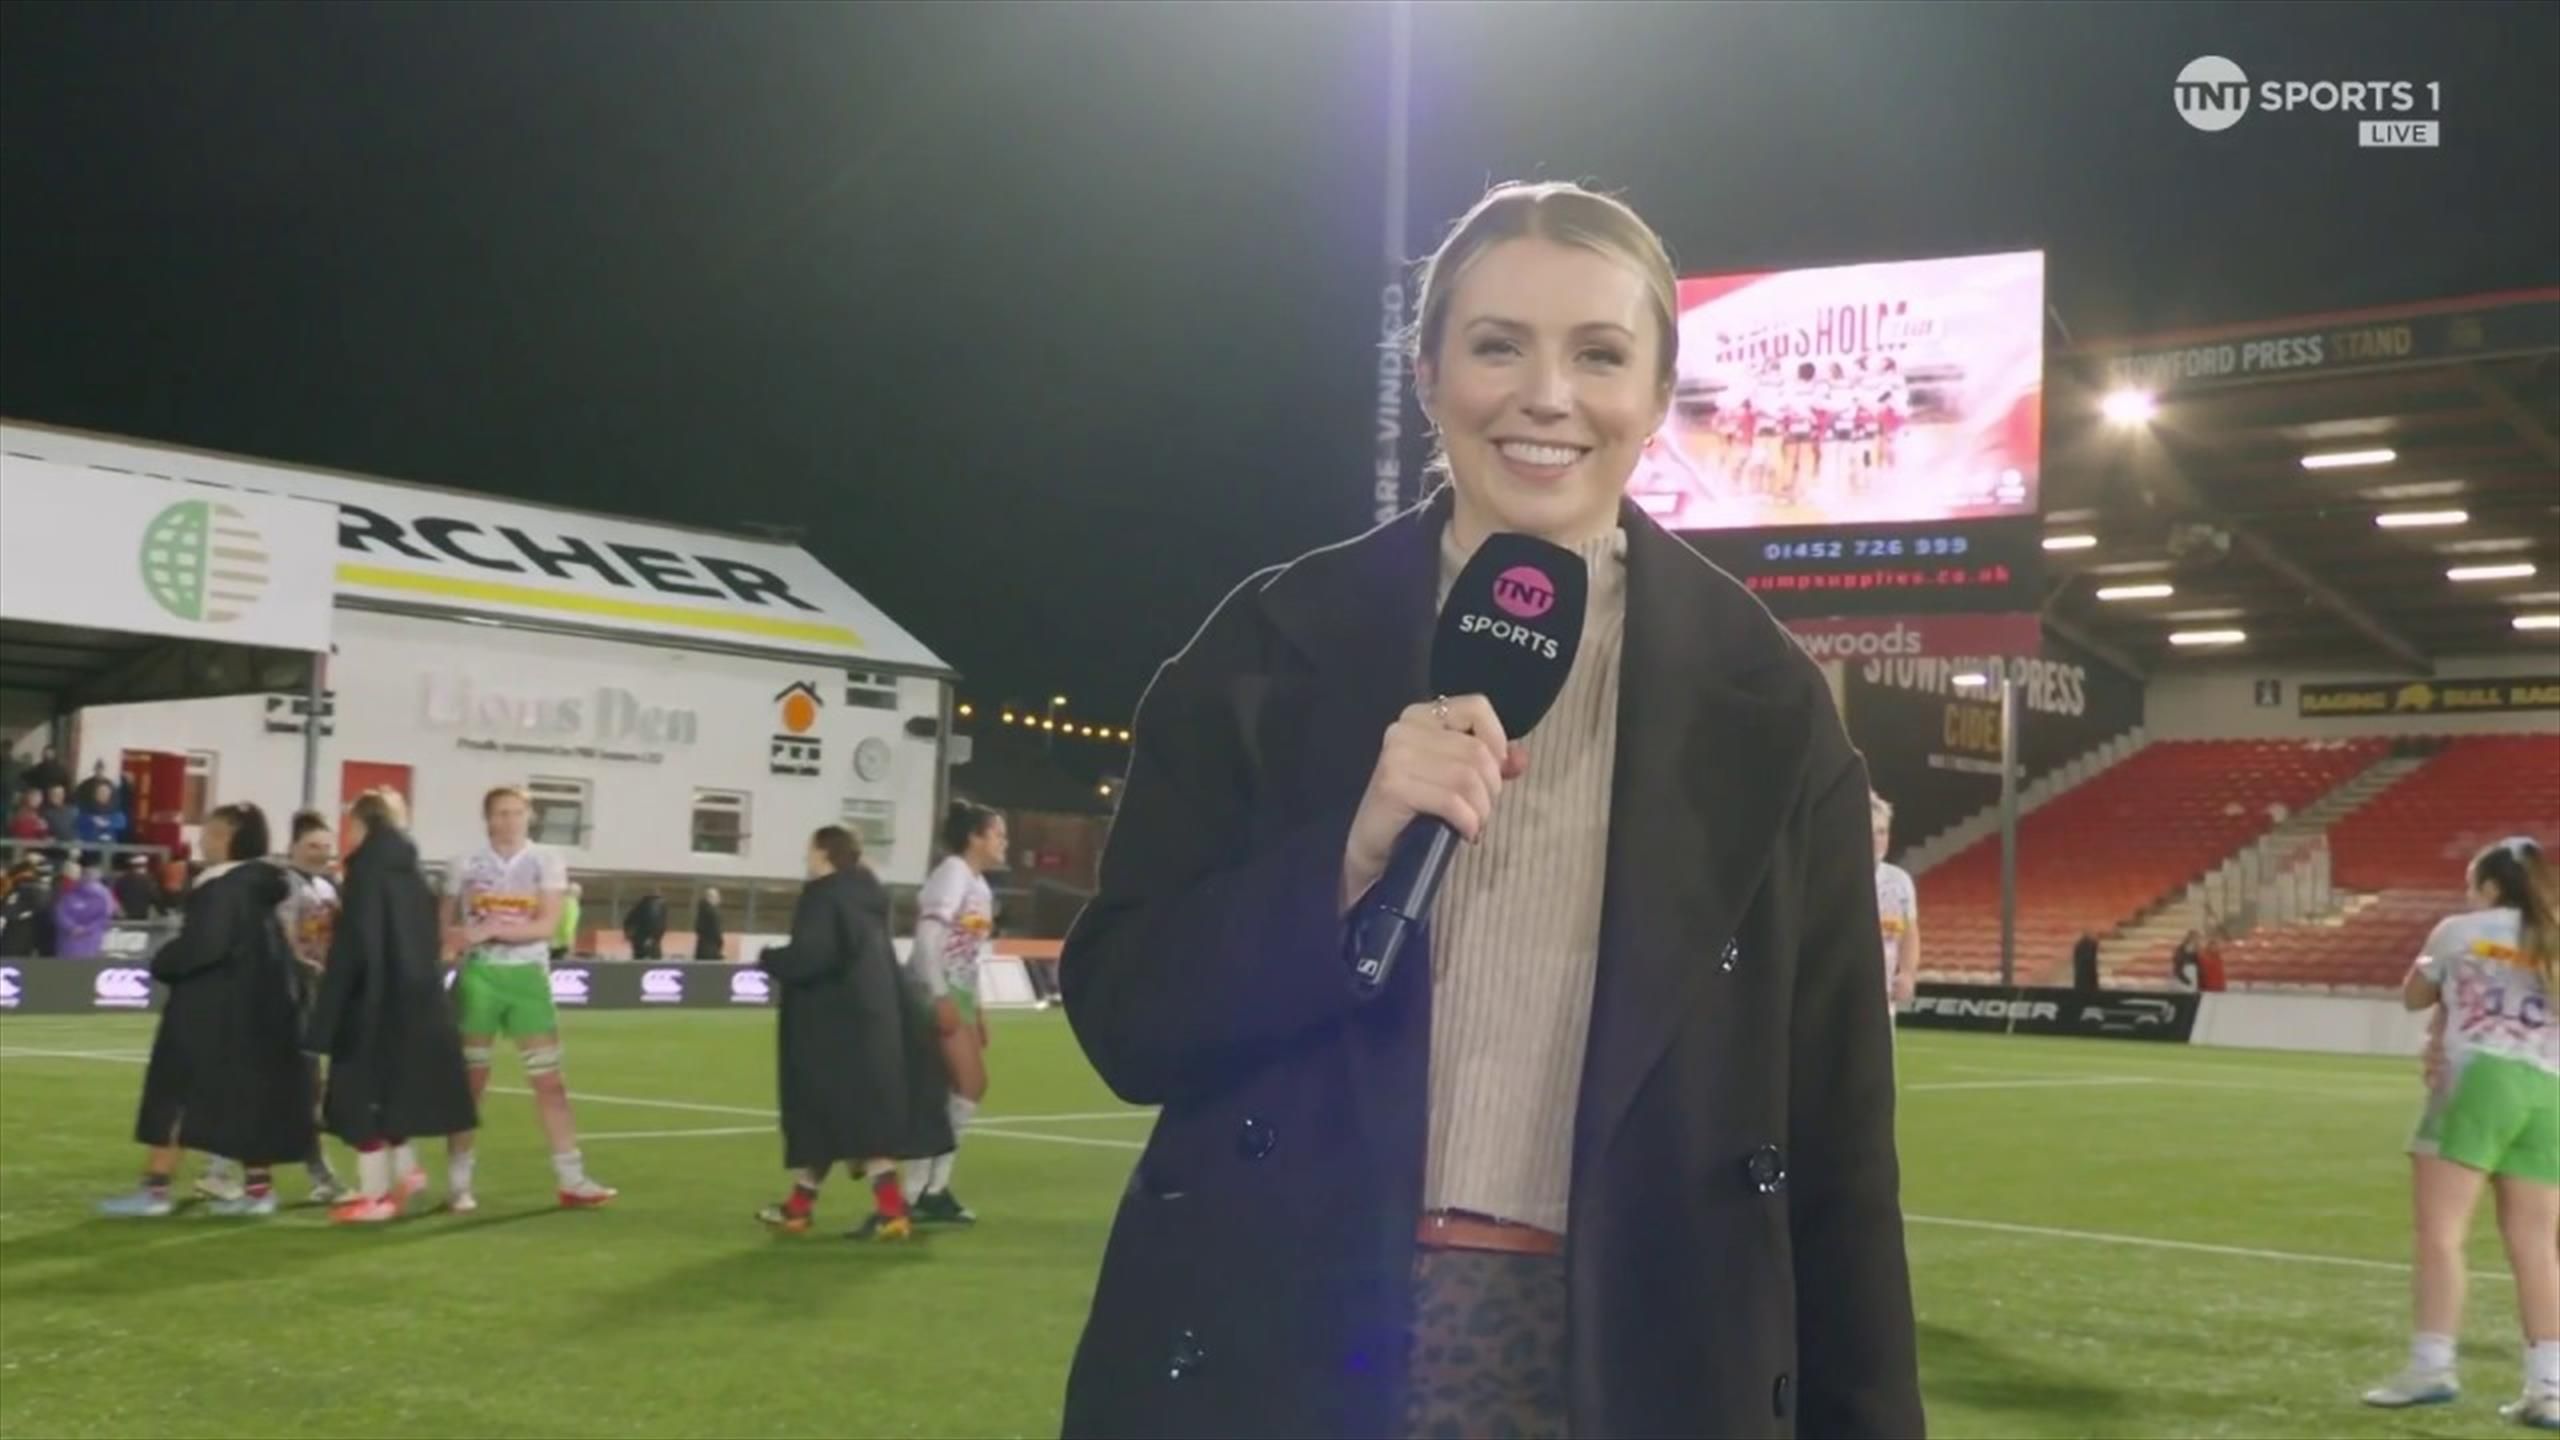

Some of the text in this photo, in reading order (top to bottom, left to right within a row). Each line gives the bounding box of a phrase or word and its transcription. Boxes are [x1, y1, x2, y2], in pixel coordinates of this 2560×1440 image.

[2242, 335, 2324, 372] PRESS
[2333, 326, 2412, 360] STAND
[338, 503, 824, 613] RCHER
[1764, 541, 1842, 560] 01452
[1855, 539, 1903, 557] 726
[1497, 576, 1557, 609] TNT
[1459, 613, 1559, 660] SPORTS
[594, 686, 698, 745] Den
[1943, 704, 2001, 751] CIDE
